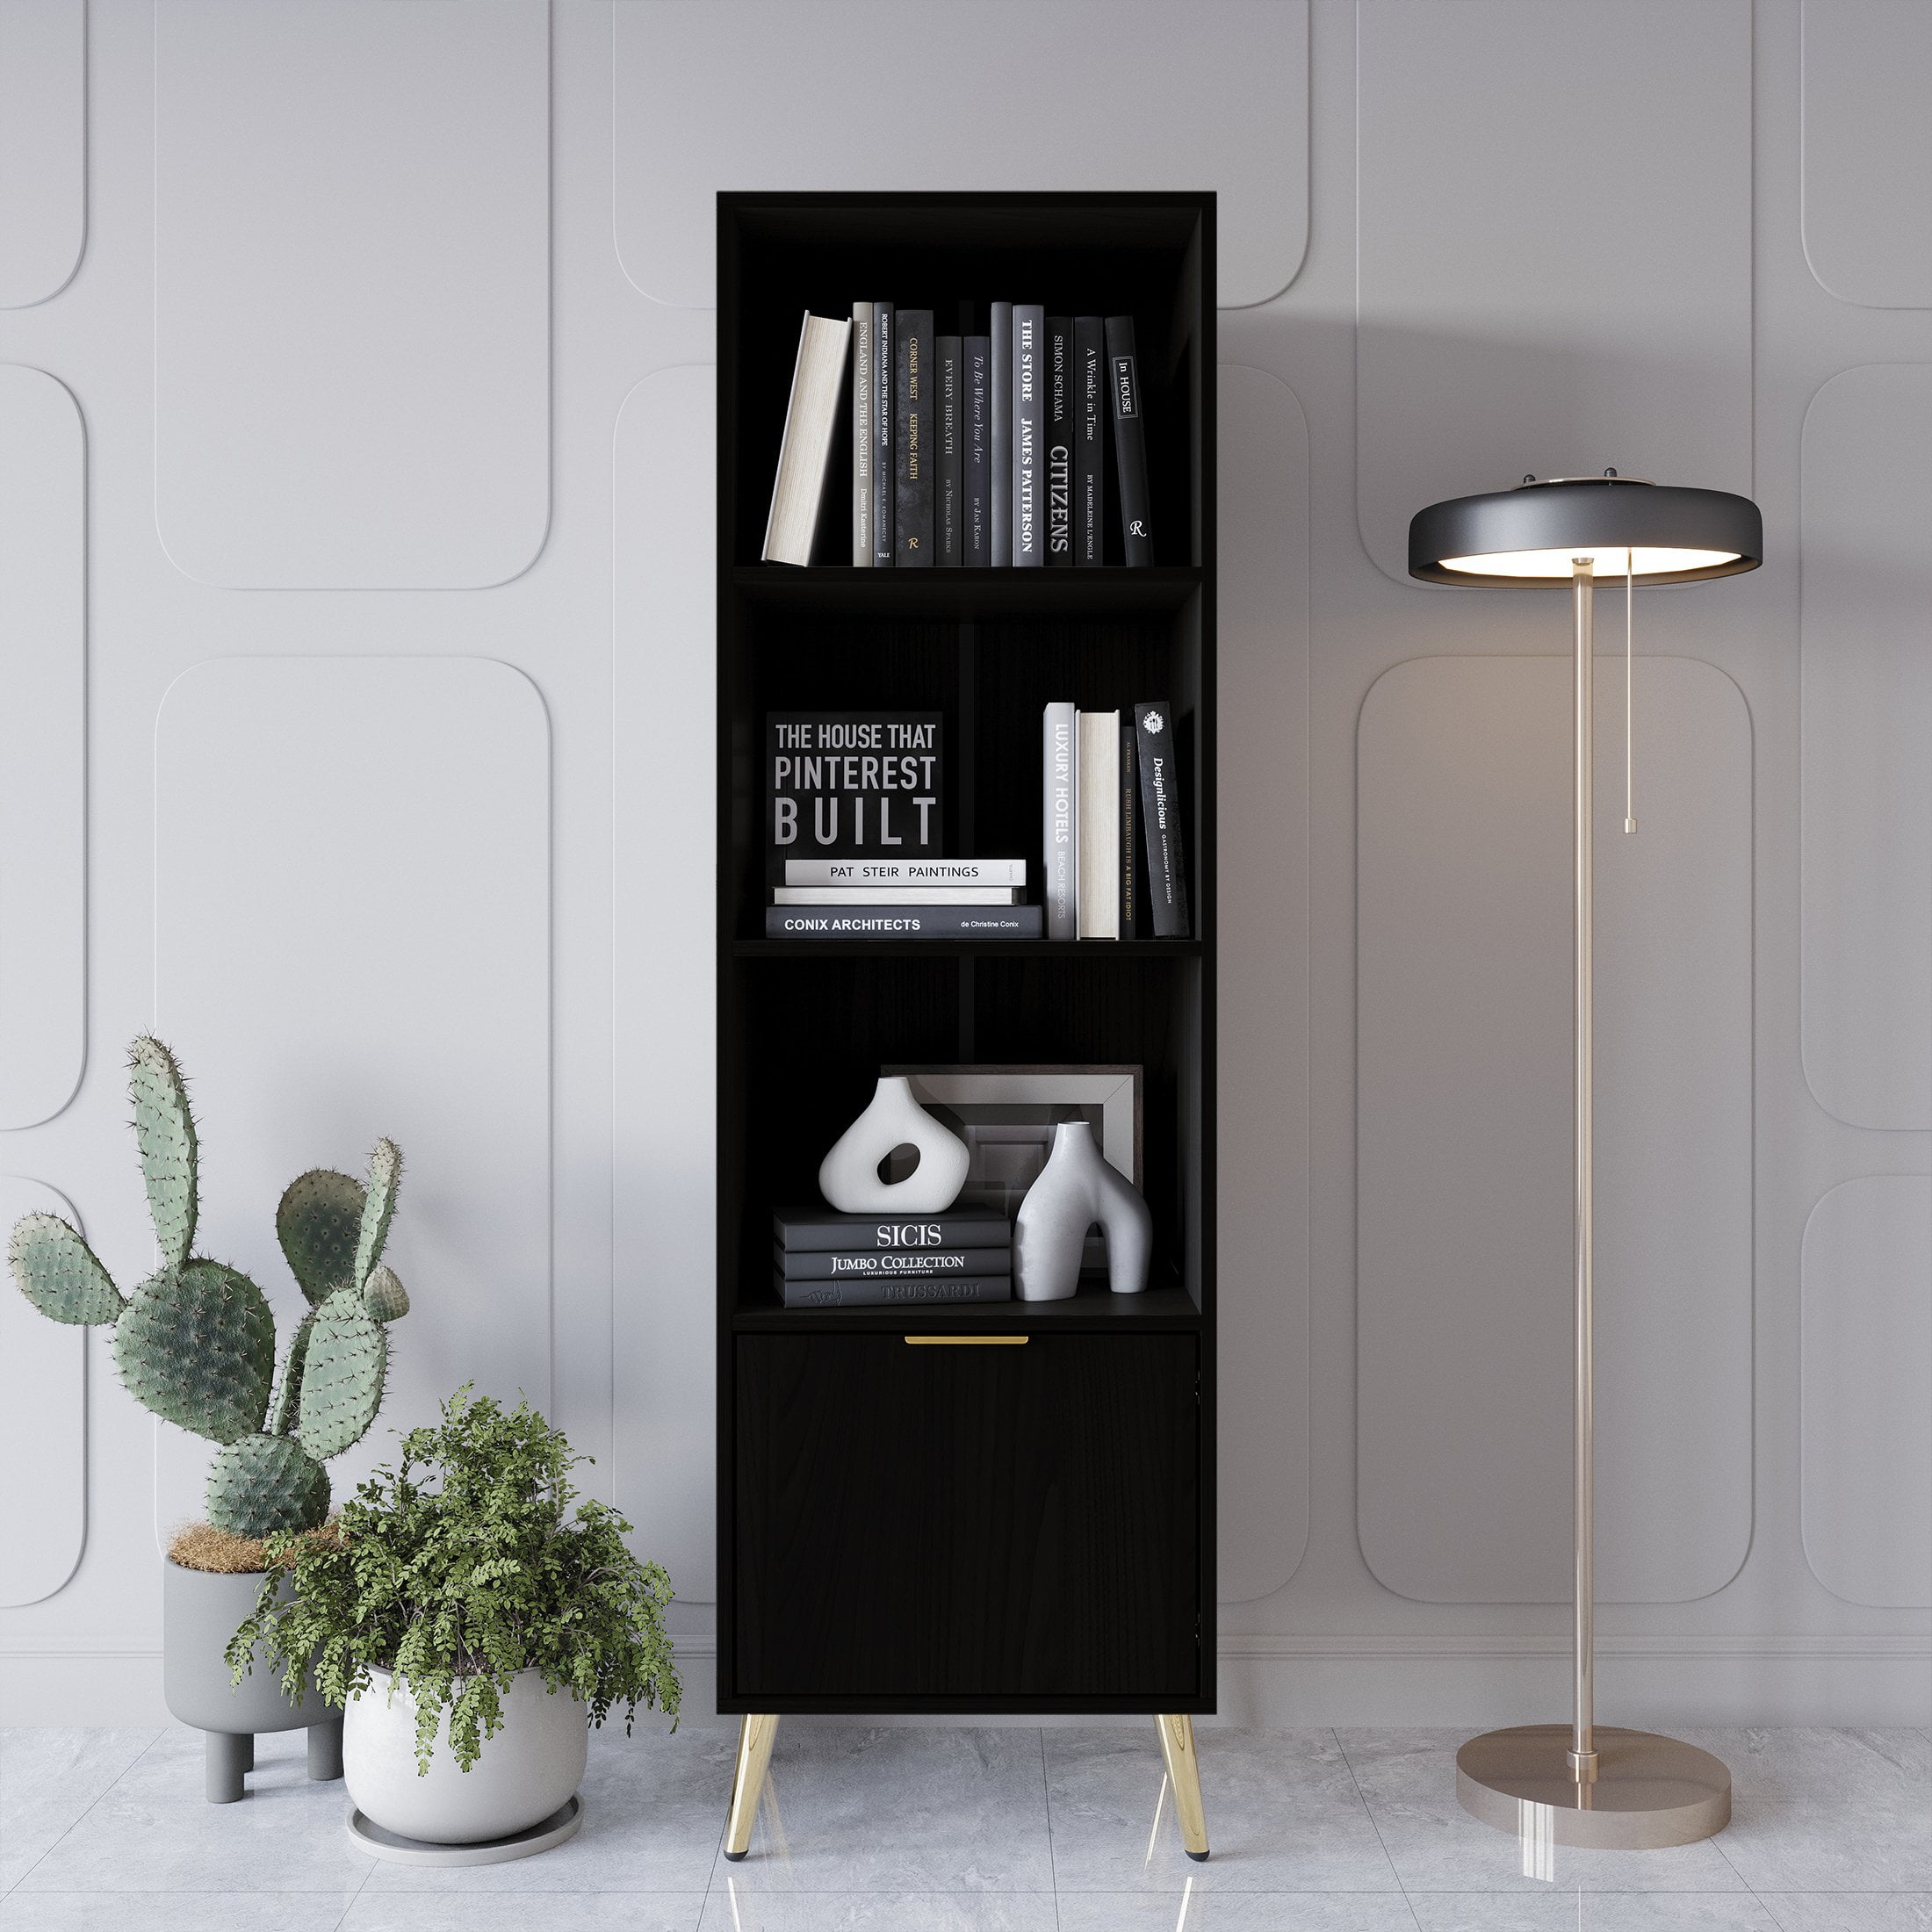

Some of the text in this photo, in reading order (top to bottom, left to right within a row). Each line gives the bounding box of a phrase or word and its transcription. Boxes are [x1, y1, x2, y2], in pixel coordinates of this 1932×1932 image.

[909, 338, 918, 400] CORNER WEST
[1021, 320, 1033, 402] THE STORE
[1054, 335, 1063, 422] SIMON SCHAMA
[973, 356, 983, 464] To Be Where You Are
[1087, 348, 1096, 441] A Wrinkle in Time
[1118, 362, 1132, 413] In HOUSE
[881, 417, 888, 426] OF
[909, 414, 918, 479] KEEPING FAITH
[1021, 418, 1033, 553] JAMES PATTERSON
[1050, 445, 1069, 553] CITIZENS
[1087, 474, 1093, 484] BY
[1130, 520, 1147, 537] R
[775, 724, 936, 749] THE HOUSE THAT
[775, 756, 937, 789] PINTEREST
[1055, 724, 1069, 844] LUXURY HOTELS
[1153, 757, 1167, 830] Designlicious
[775, 797, 937, 845] BUILT
[830, 866, 979, 877] PAT STEIR PAINTINGS
[1125, 855, 1132, 864] IS
[1057, 851, 1066, 919] BEACH RESORTS
[784, 919, 921, 931] CONIX ARCHITECTS
[877, 1224, 942, 1247] SICIS
[831, 1256, 965, 1274] JUMBO COLLECTION
[882, 1283, 980, 1300] TRUSSARDI
